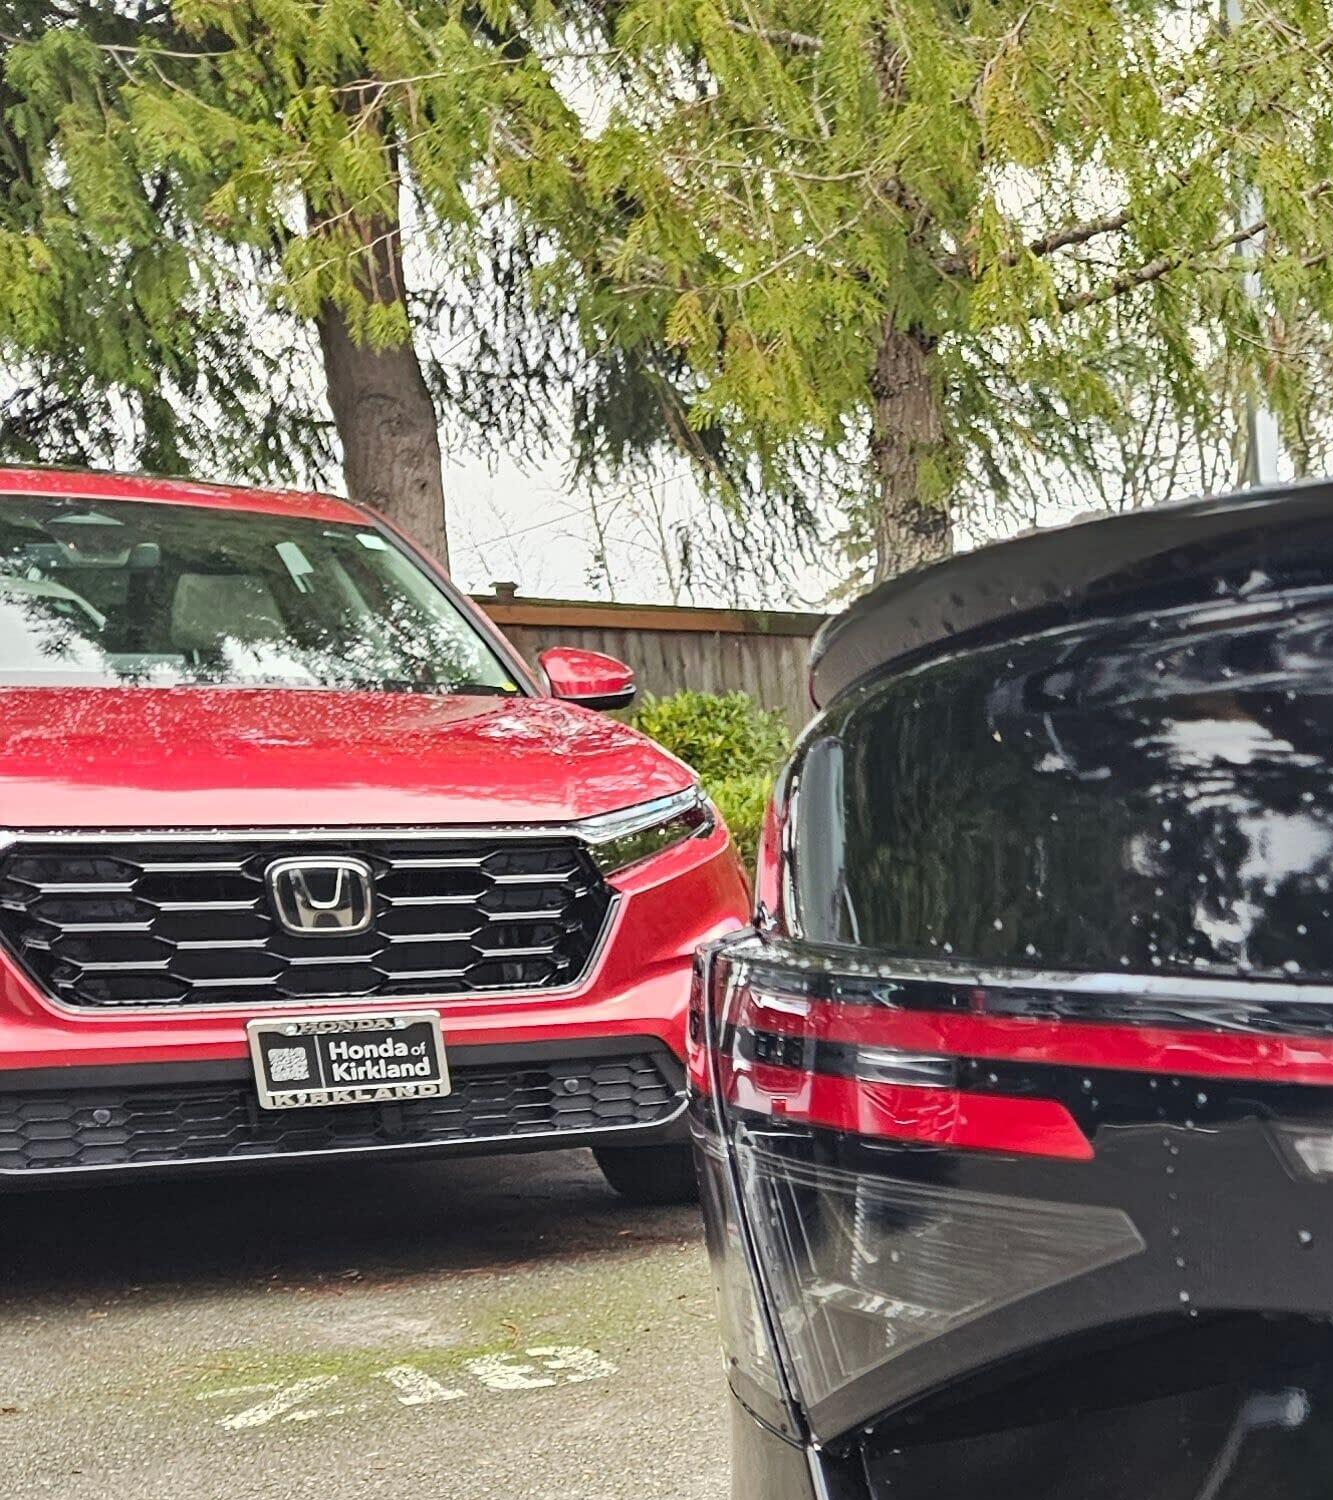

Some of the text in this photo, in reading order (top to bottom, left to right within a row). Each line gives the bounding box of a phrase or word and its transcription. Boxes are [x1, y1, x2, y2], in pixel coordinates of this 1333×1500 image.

[300, 1018, 393, 1034] HONDA
[328, 1037, 426, 1061] Honda of
[332, 1056, 431, 1082] Kirkland
